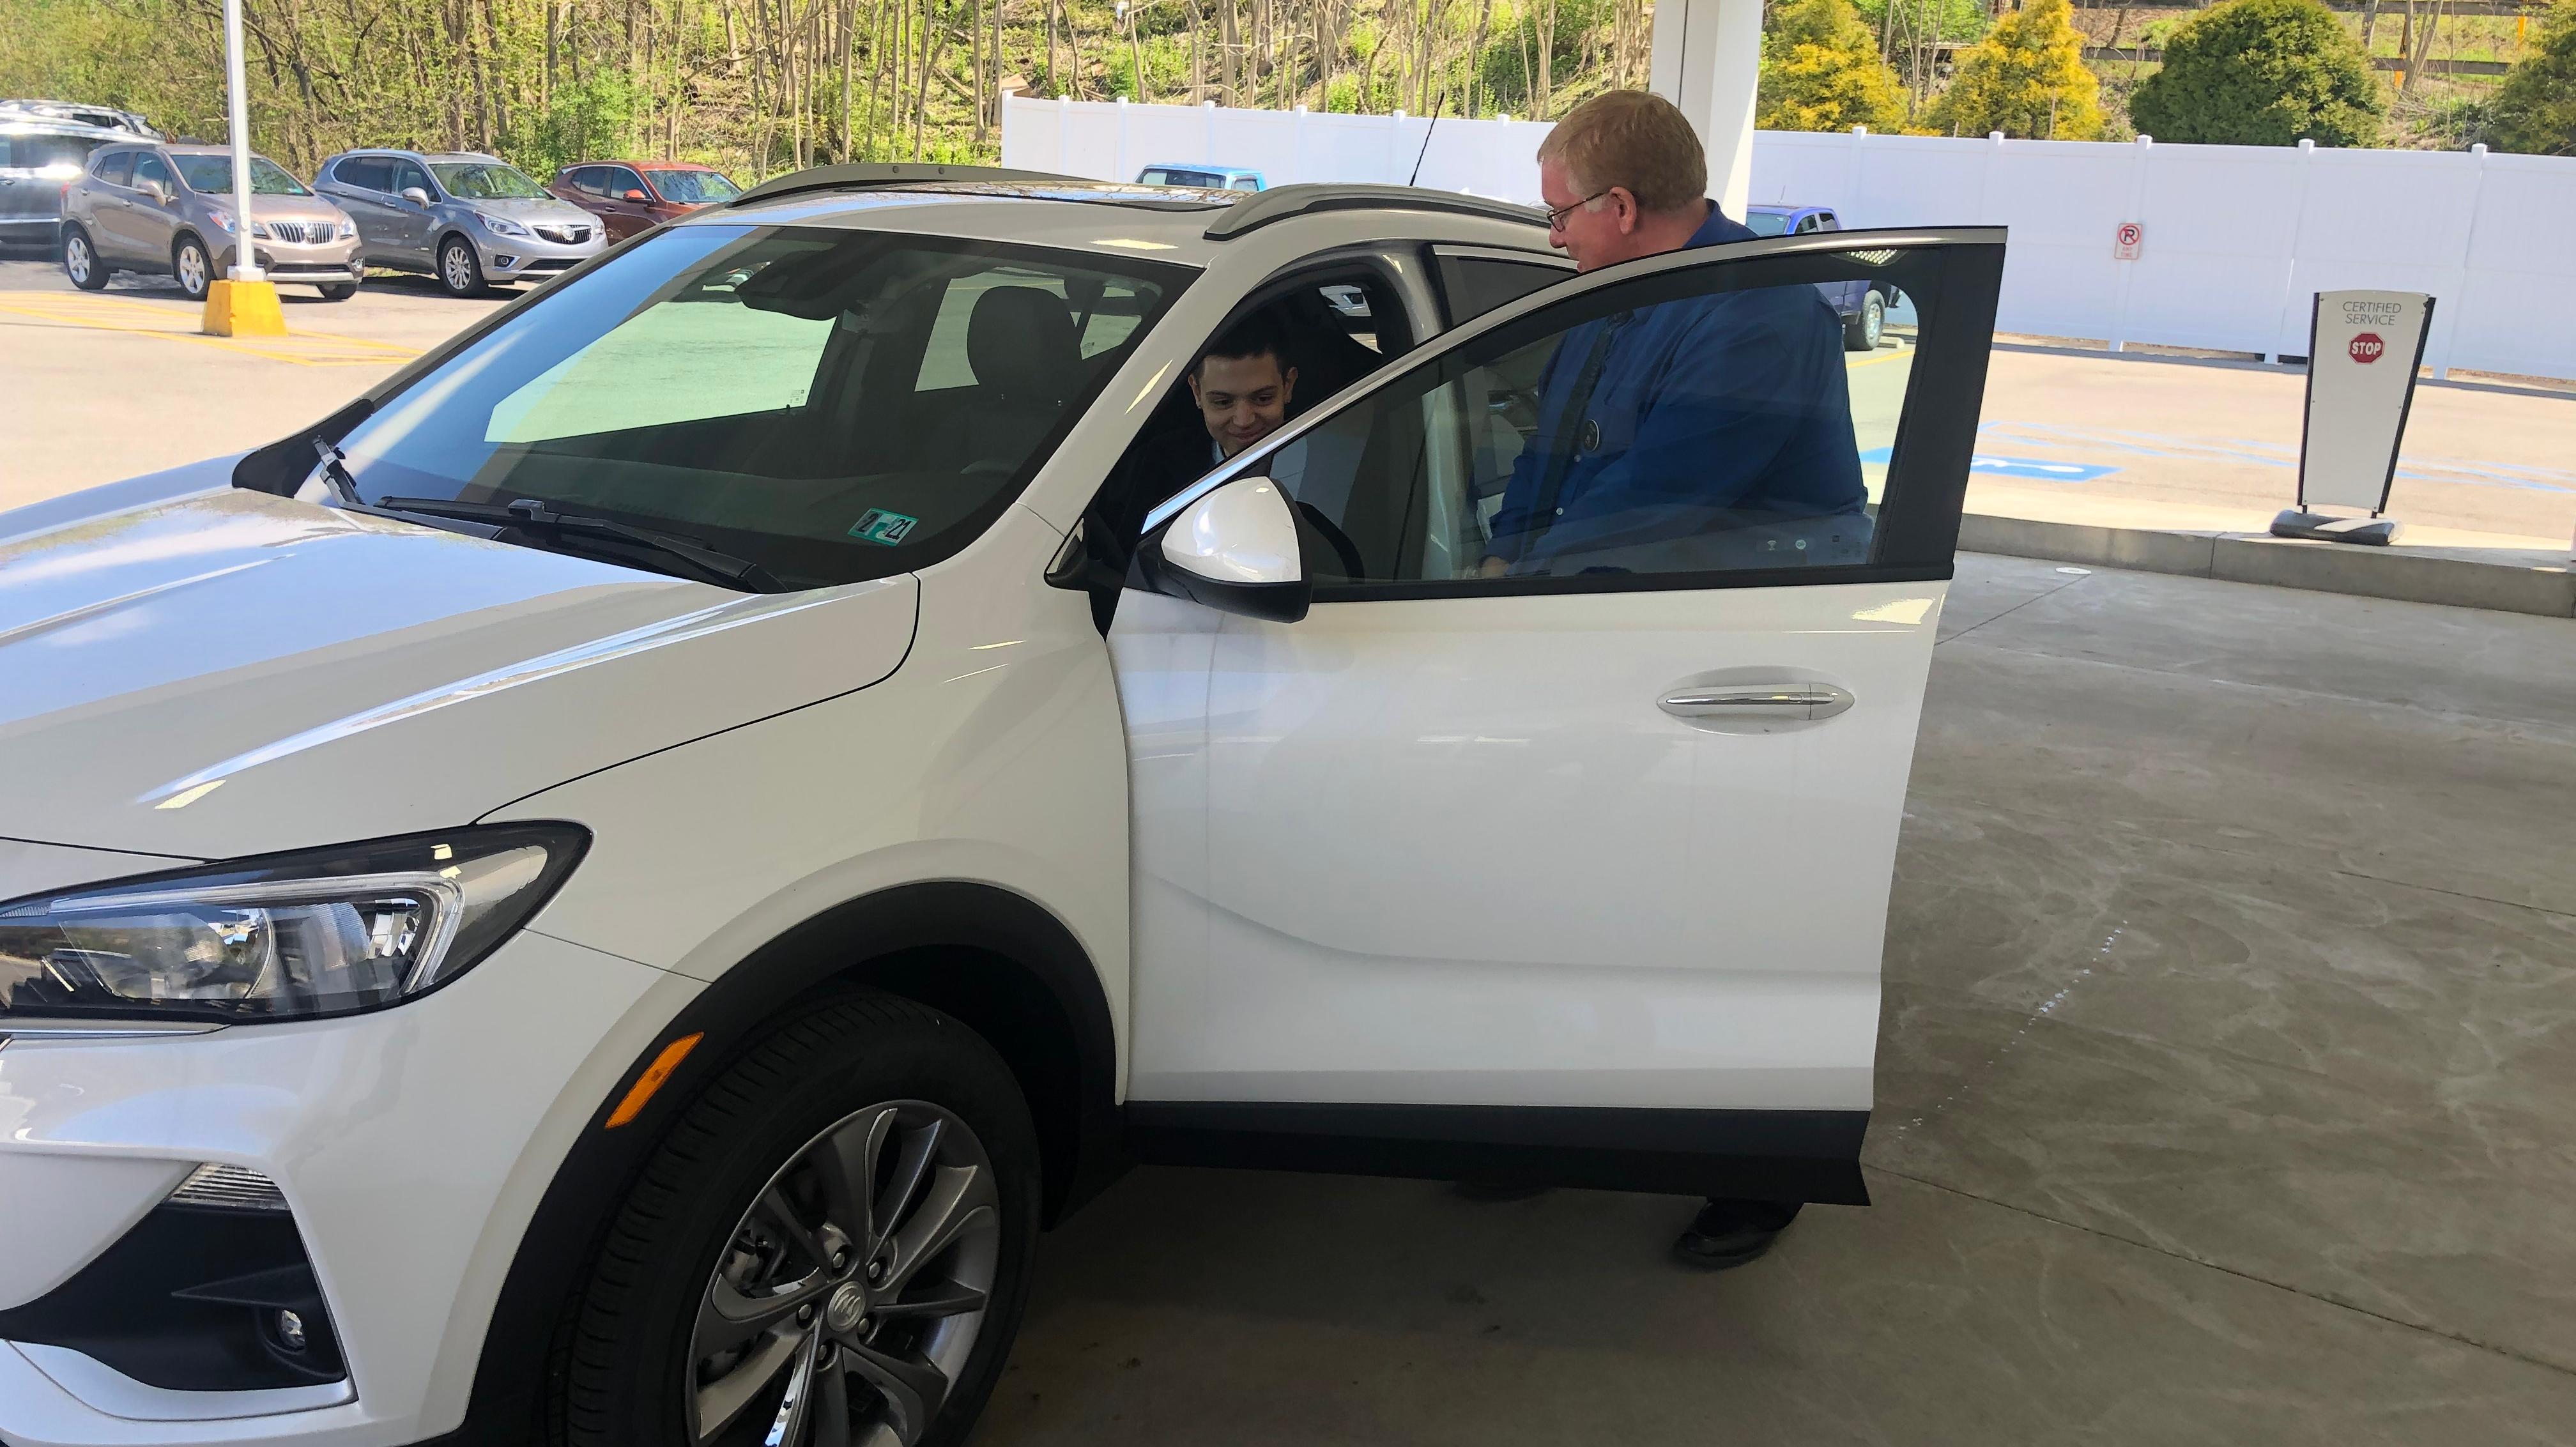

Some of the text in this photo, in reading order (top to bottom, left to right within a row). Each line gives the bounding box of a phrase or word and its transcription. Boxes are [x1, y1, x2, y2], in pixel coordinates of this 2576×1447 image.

[2342, 301, 2402, 313] CERTIFIED
[2345, 314, 2396, 326] SERVICE
[2351, 341, 2382, 355] STOP
[884, 518, 912, 540] 21
